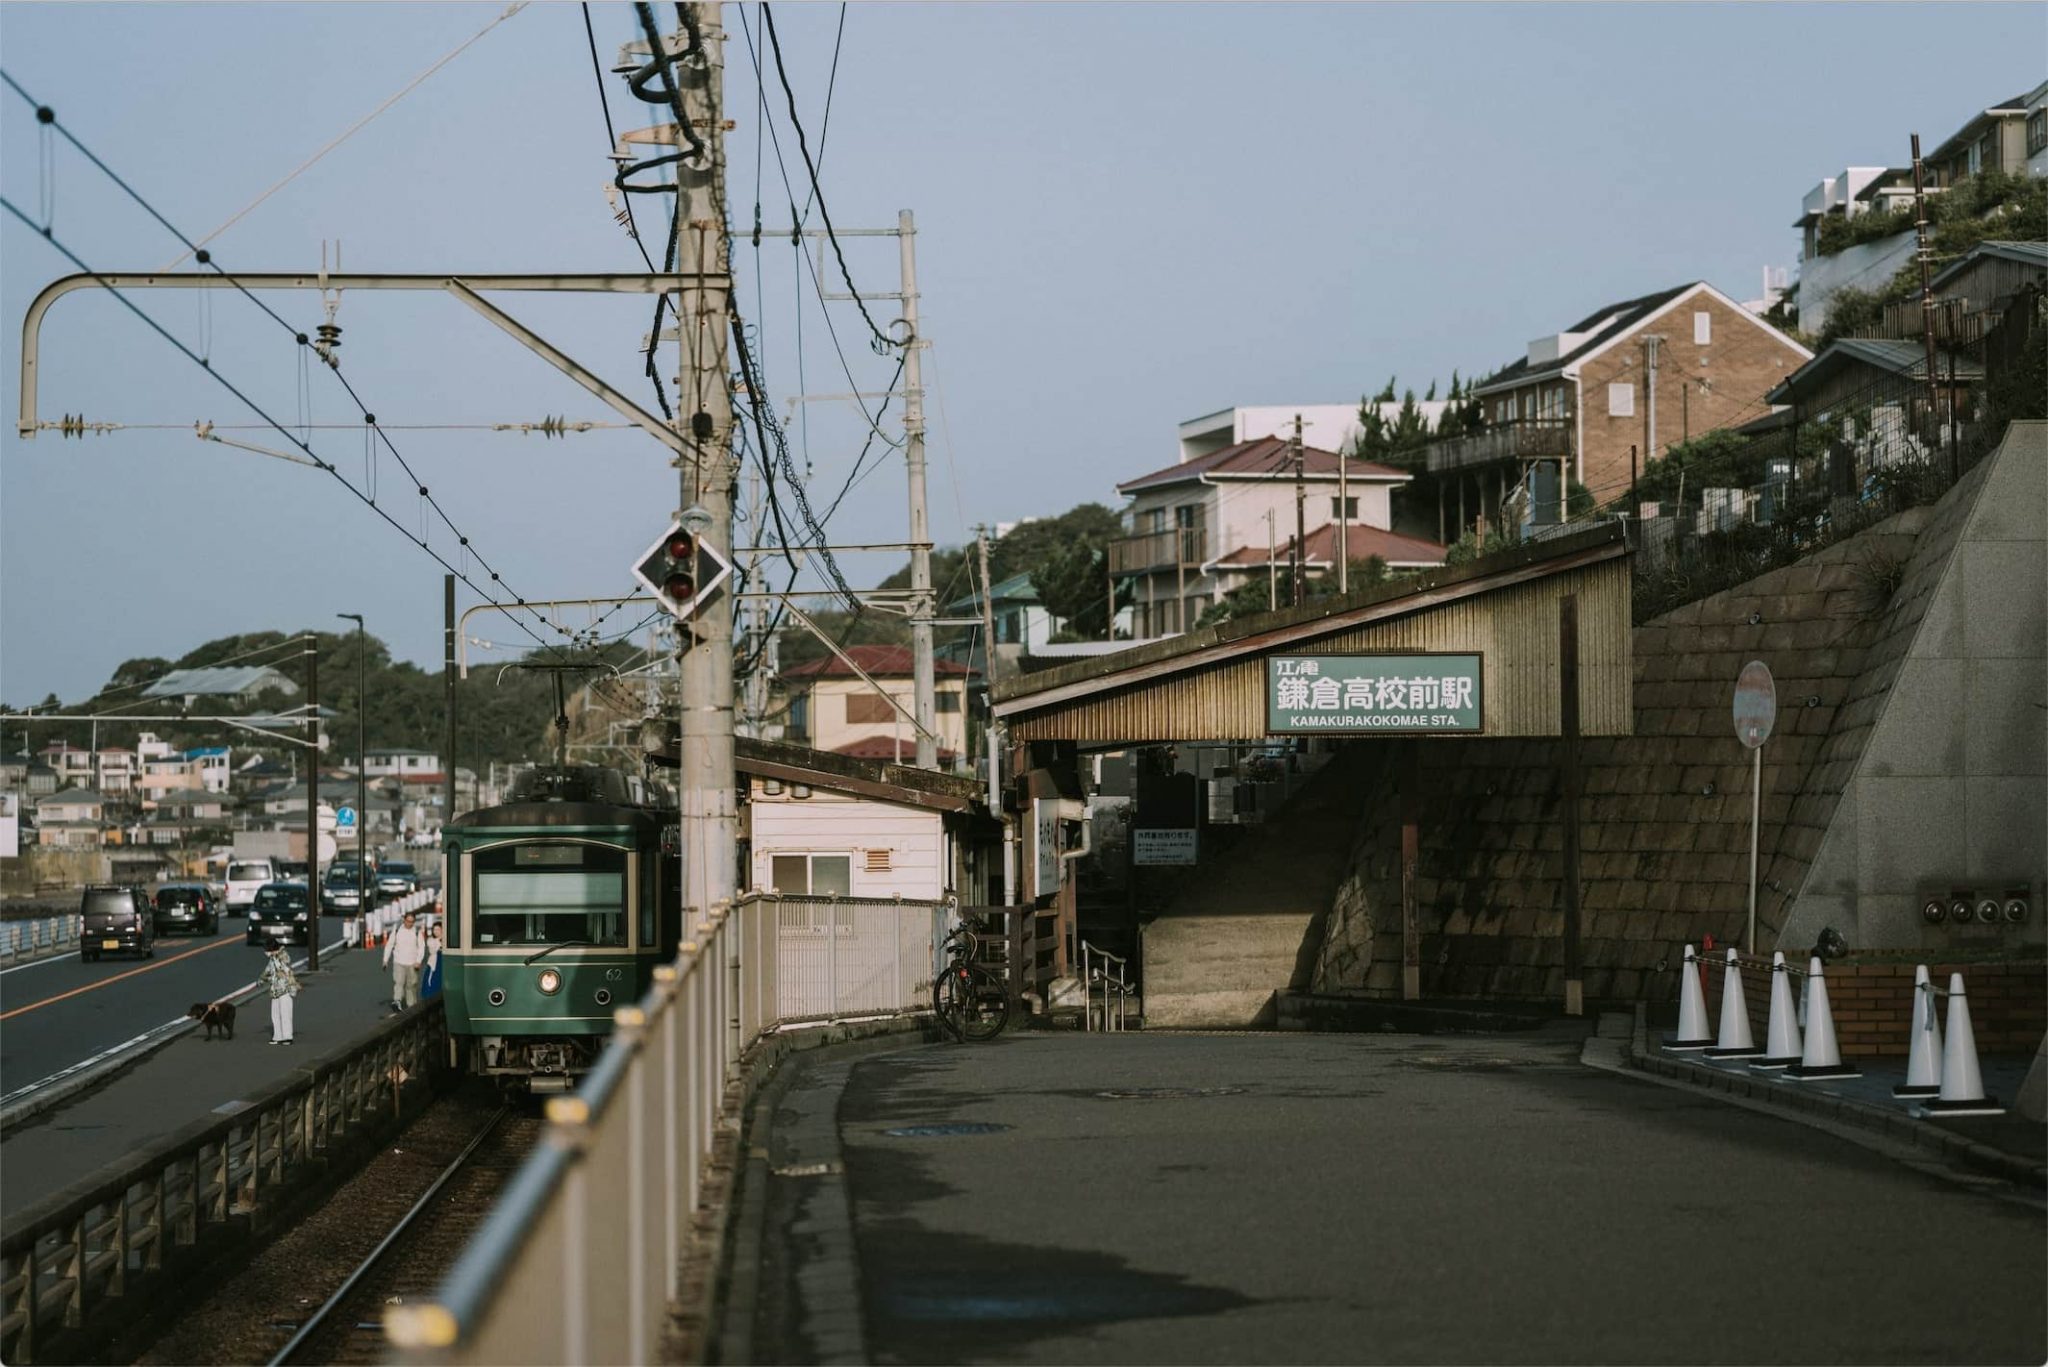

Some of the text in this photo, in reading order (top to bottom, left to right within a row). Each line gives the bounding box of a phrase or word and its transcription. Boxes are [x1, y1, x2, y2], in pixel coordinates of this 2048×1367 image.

[1276, 676, 1473, 710] 鎌倉高校前駅
[1290, 715, 1460, 727] KAMAKURAKOKOMAE STA.
[606, 968, 622, 981] 62
